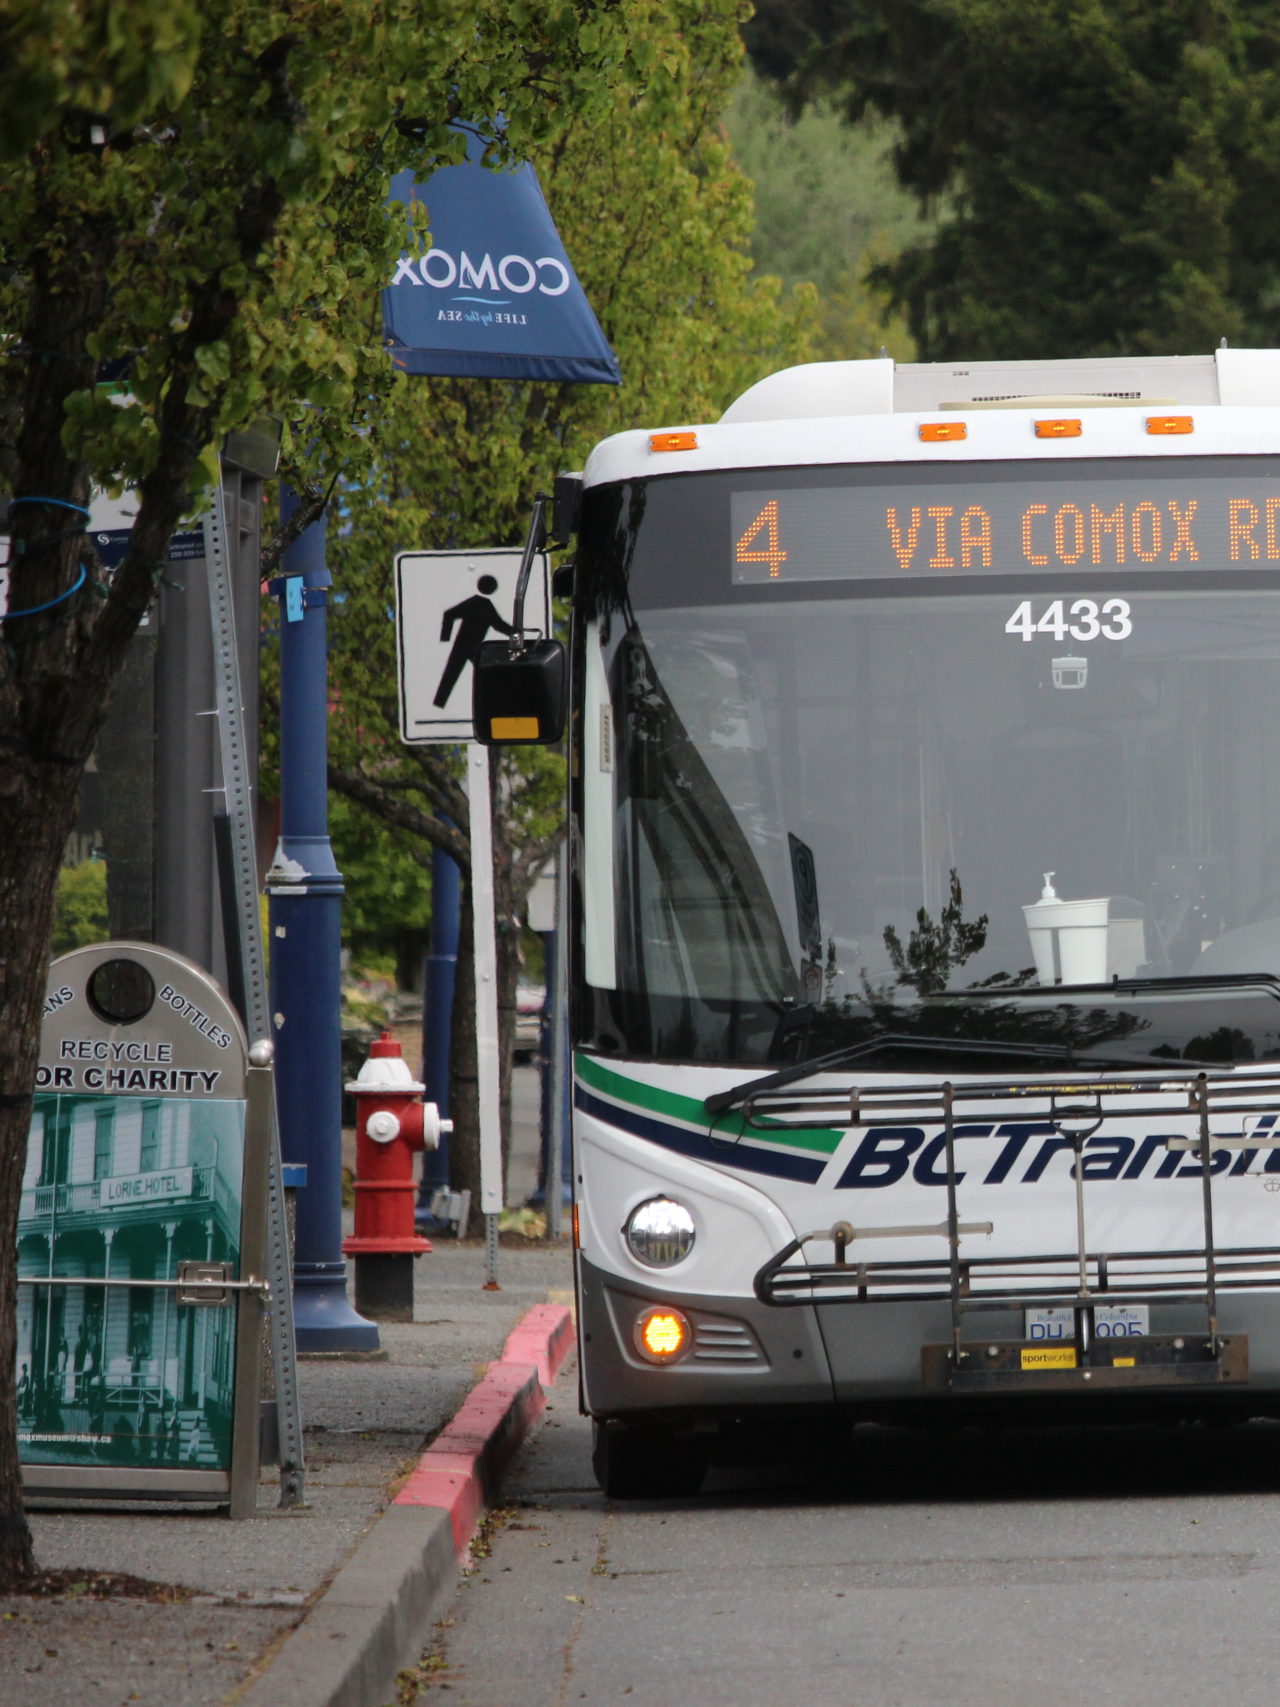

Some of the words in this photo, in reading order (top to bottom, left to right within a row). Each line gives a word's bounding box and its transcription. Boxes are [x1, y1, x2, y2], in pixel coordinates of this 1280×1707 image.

[735, 500, 788, 577] 4
[886, 505, 993, 569] VIA
[1022, 500, 1200, 566] COMOX
[1004, 598, 1133, 642] 4433
[158, 984, 232, 1049] BOTTLES
[60, 1040, 172, 1063] RECYCLE
[84, 1068, 220, 1093] CHARITY
[1022, 1353, 1074, 1364] sportworks
